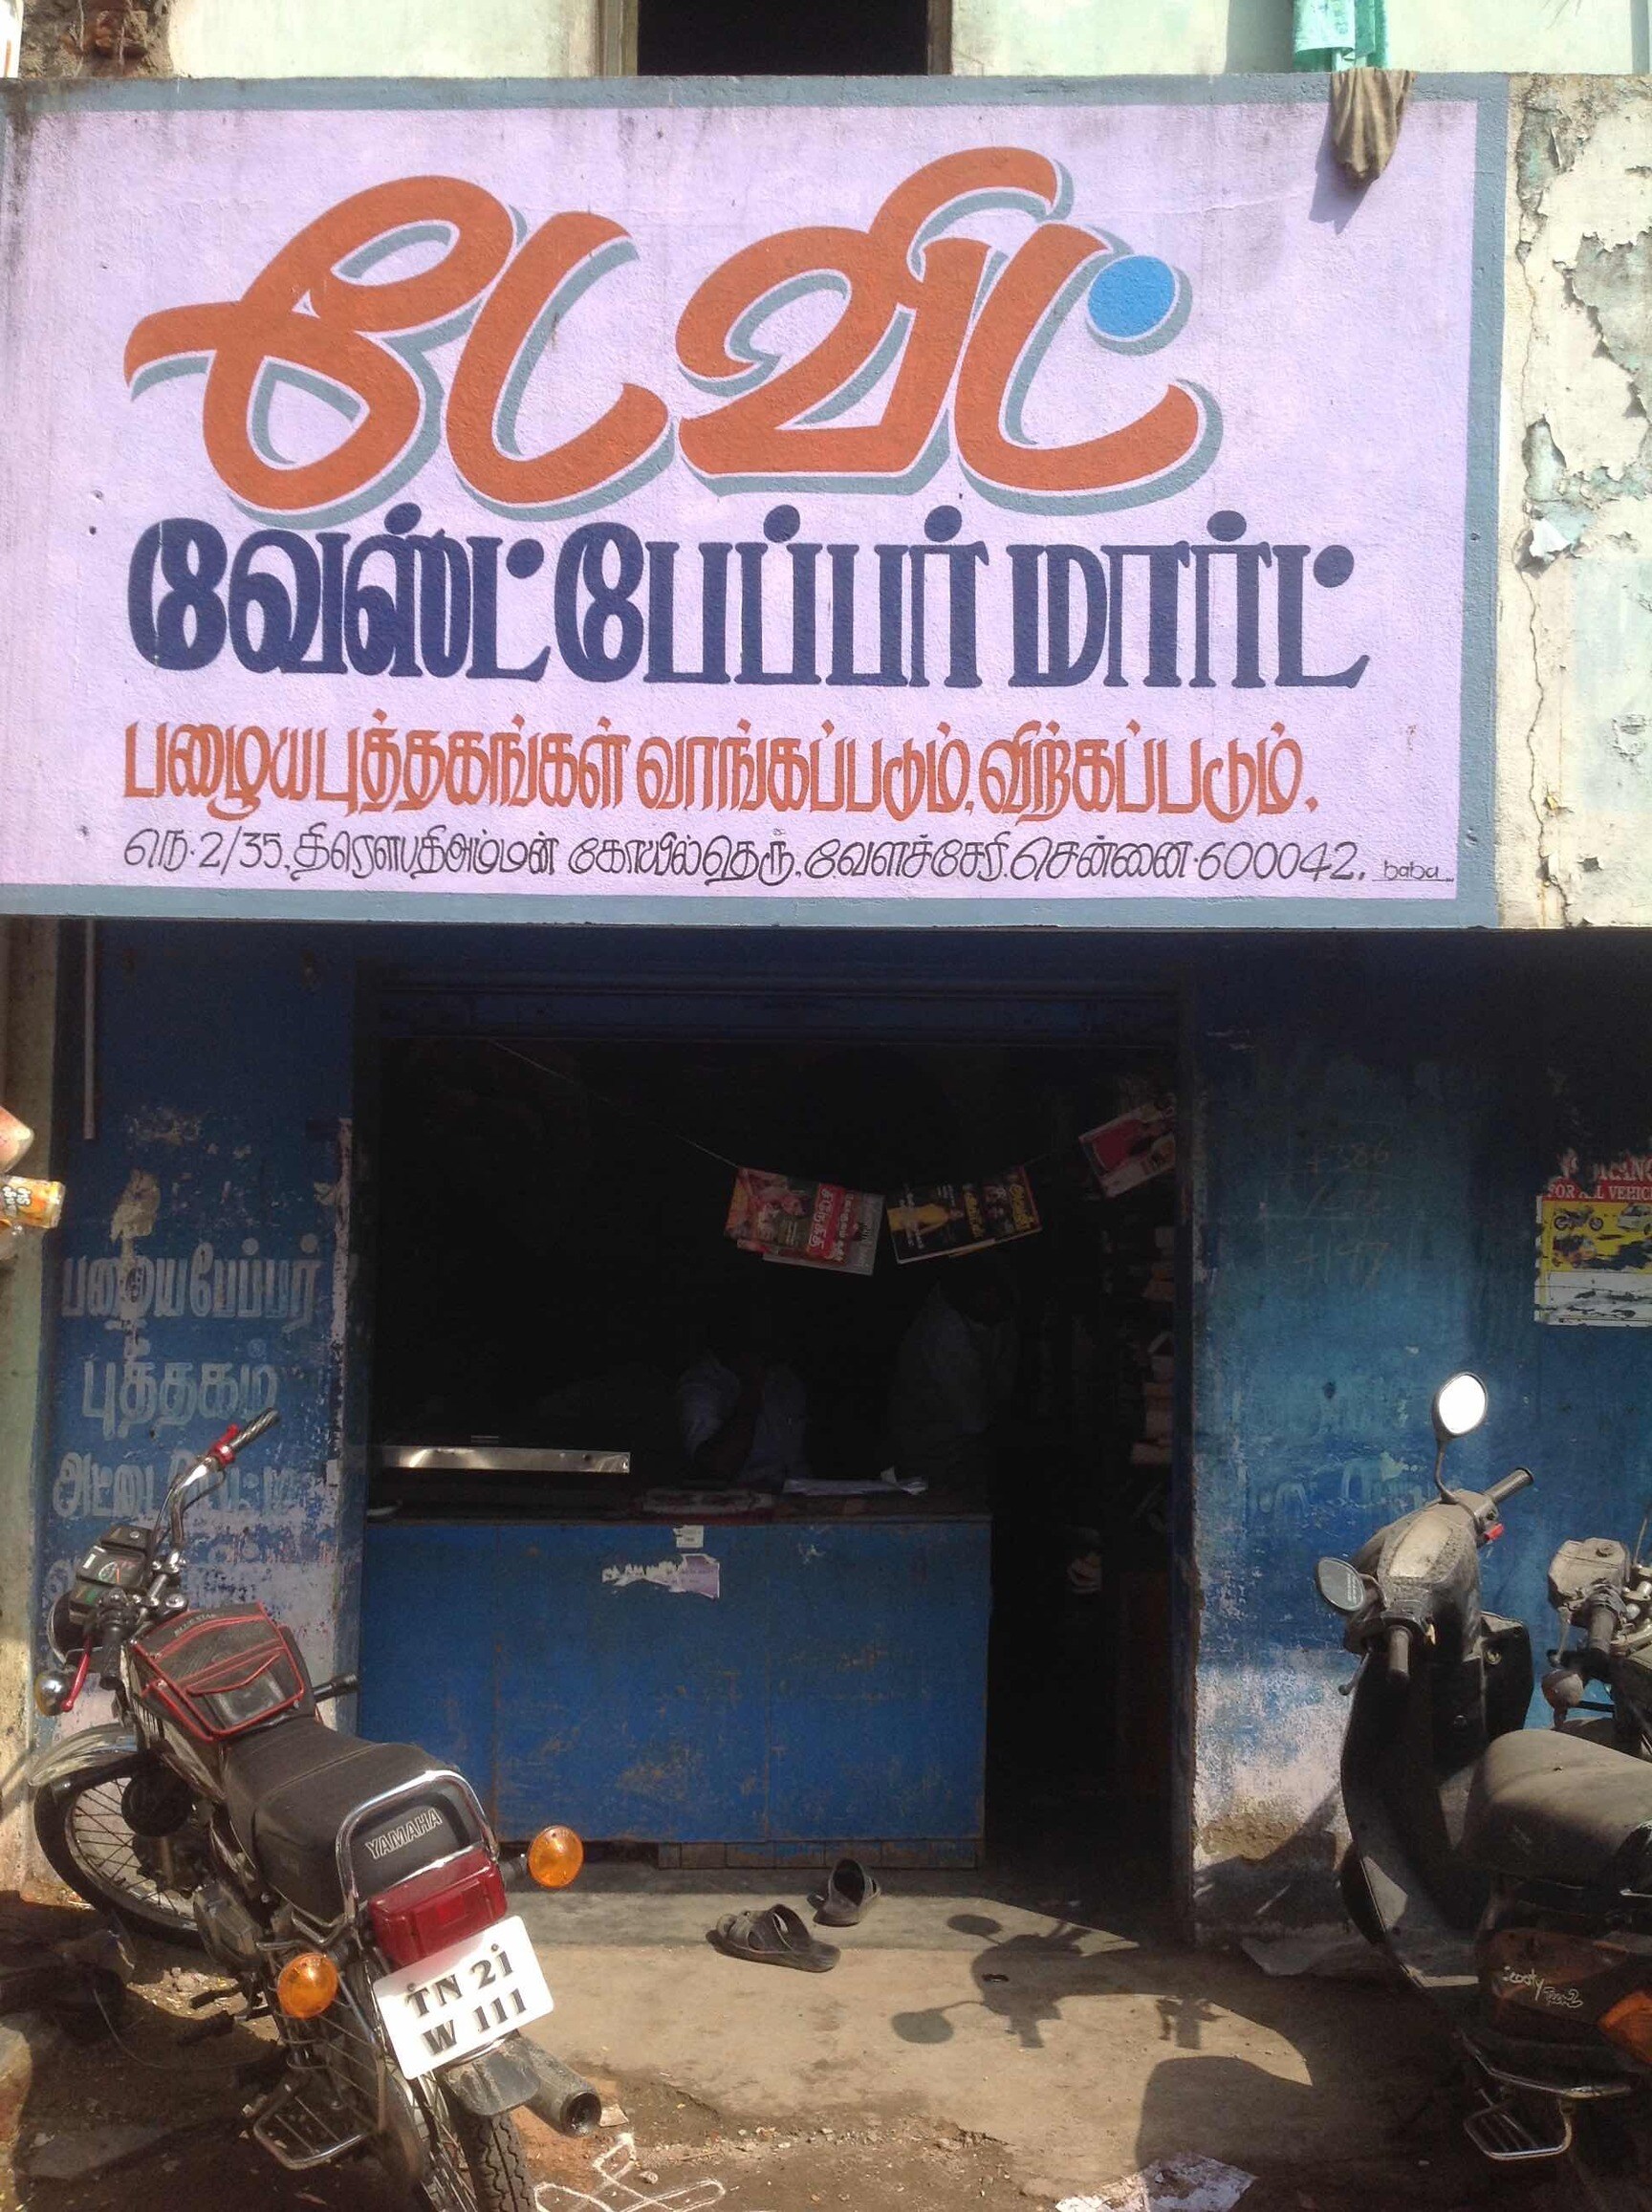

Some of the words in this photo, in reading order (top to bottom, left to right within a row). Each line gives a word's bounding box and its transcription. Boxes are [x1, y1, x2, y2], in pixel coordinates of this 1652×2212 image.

[124, 146, 1220, 514] டேவிட்
[1007, 510, 1370, 689] மார்ட்
[1609, 1185, 1652, 1201] VEHIC
[365, 1807, 443, 1859] YAMAHA
[405, 1975, 463, 2018] TN
[470, 1950, 513, 1990] 21
[420, 2020, 458, 2056] W
[472, 1988, 527, 2034] 111
